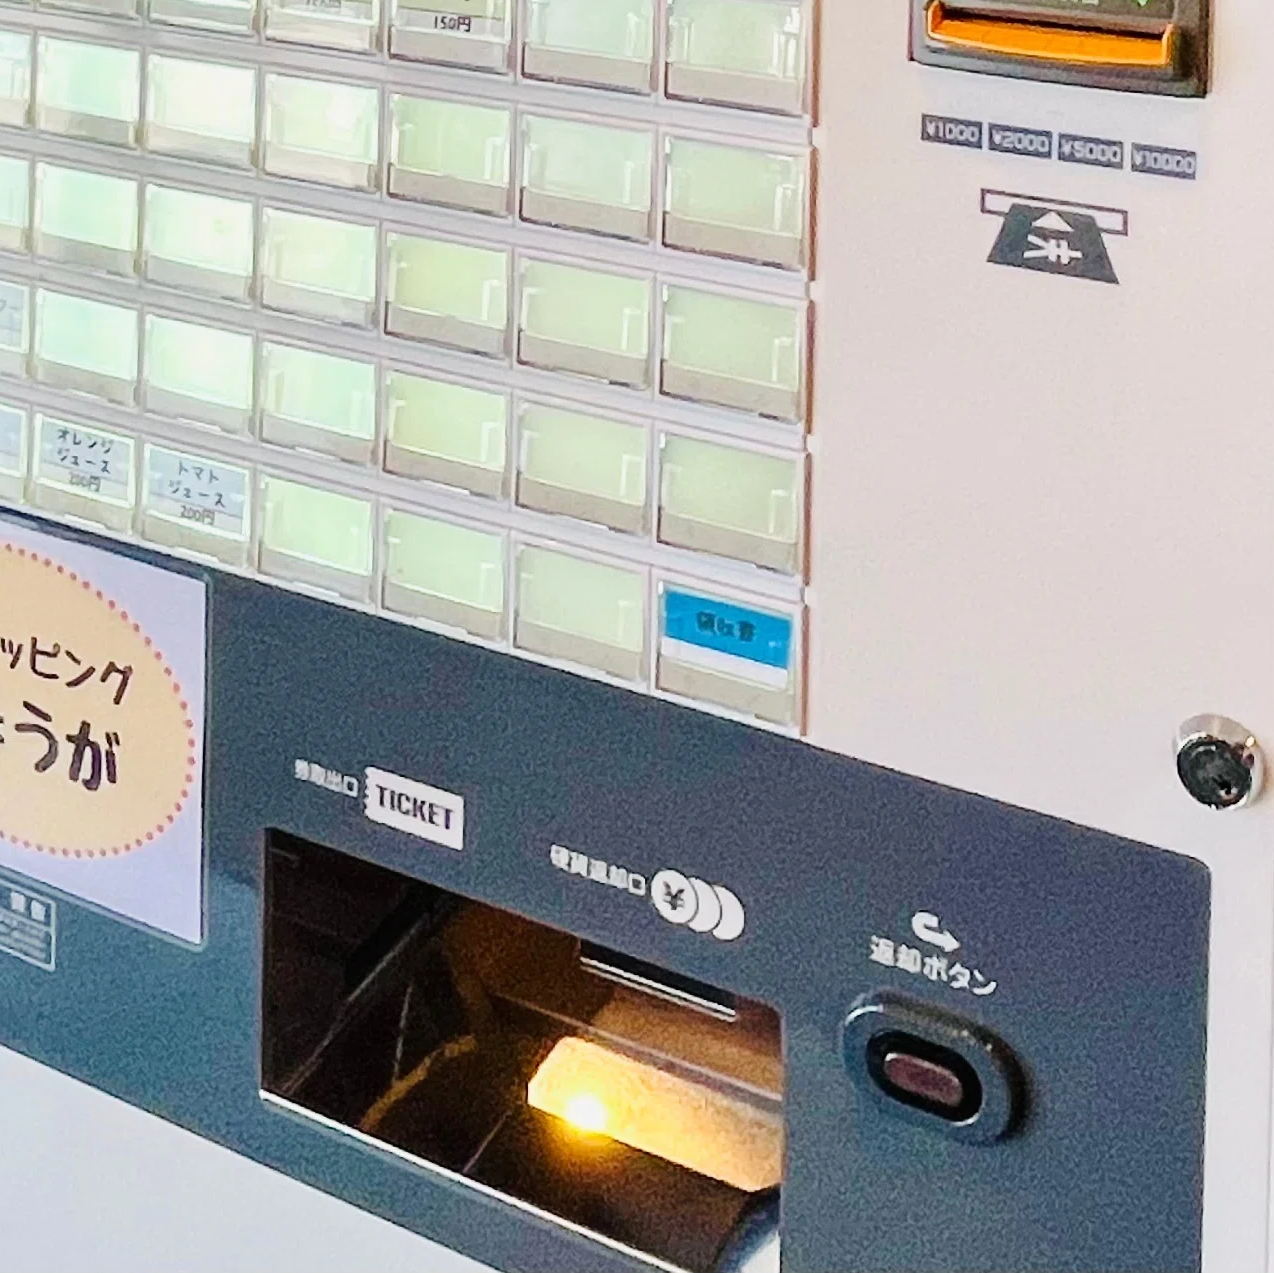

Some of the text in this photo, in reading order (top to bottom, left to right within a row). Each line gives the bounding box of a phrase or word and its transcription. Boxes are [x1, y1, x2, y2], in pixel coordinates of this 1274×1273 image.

[434, 15, 472, 32] 150円
[926, 118, 980, 144] ¥1000
[989, 126, 1051, 154] ¥2000
[1060, 136, 1123, 165] ¥5000
[1132, 146, 1196, 175] ¥10000
[178, 459, 220, 484] トマト
[180, 505, 216, 525] 200円
[376, 783, 455, 830] TICKET
